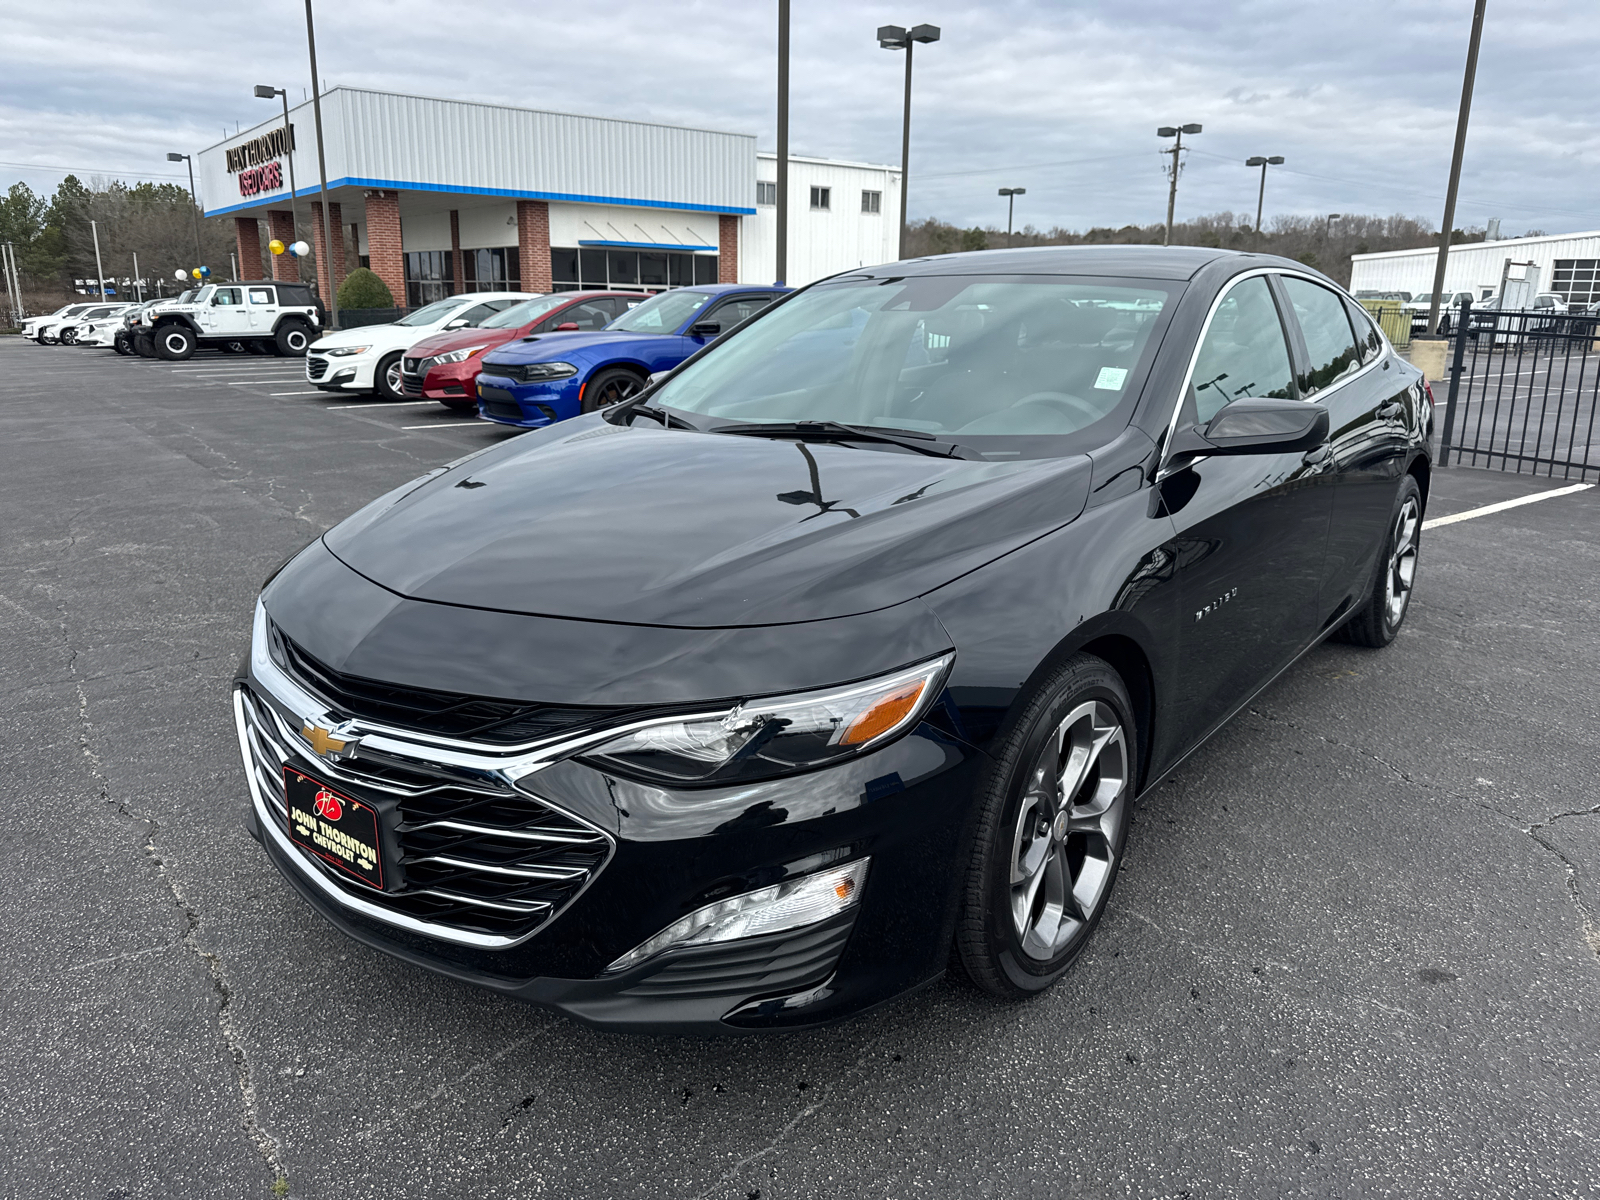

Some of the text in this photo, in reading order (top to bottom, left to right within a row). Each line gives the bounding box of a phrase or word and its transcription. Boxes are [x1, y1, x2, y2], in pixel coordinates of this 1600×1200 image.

[225, 142, 247, 174] JOHN
[238, 161, 283, 197] USED CARS
[1194, 587, 1238, 622] MALIBU
[291, 806, 377, 864] JOHN THORNTON
[312, 832, 354, 863] CHEVROLET
